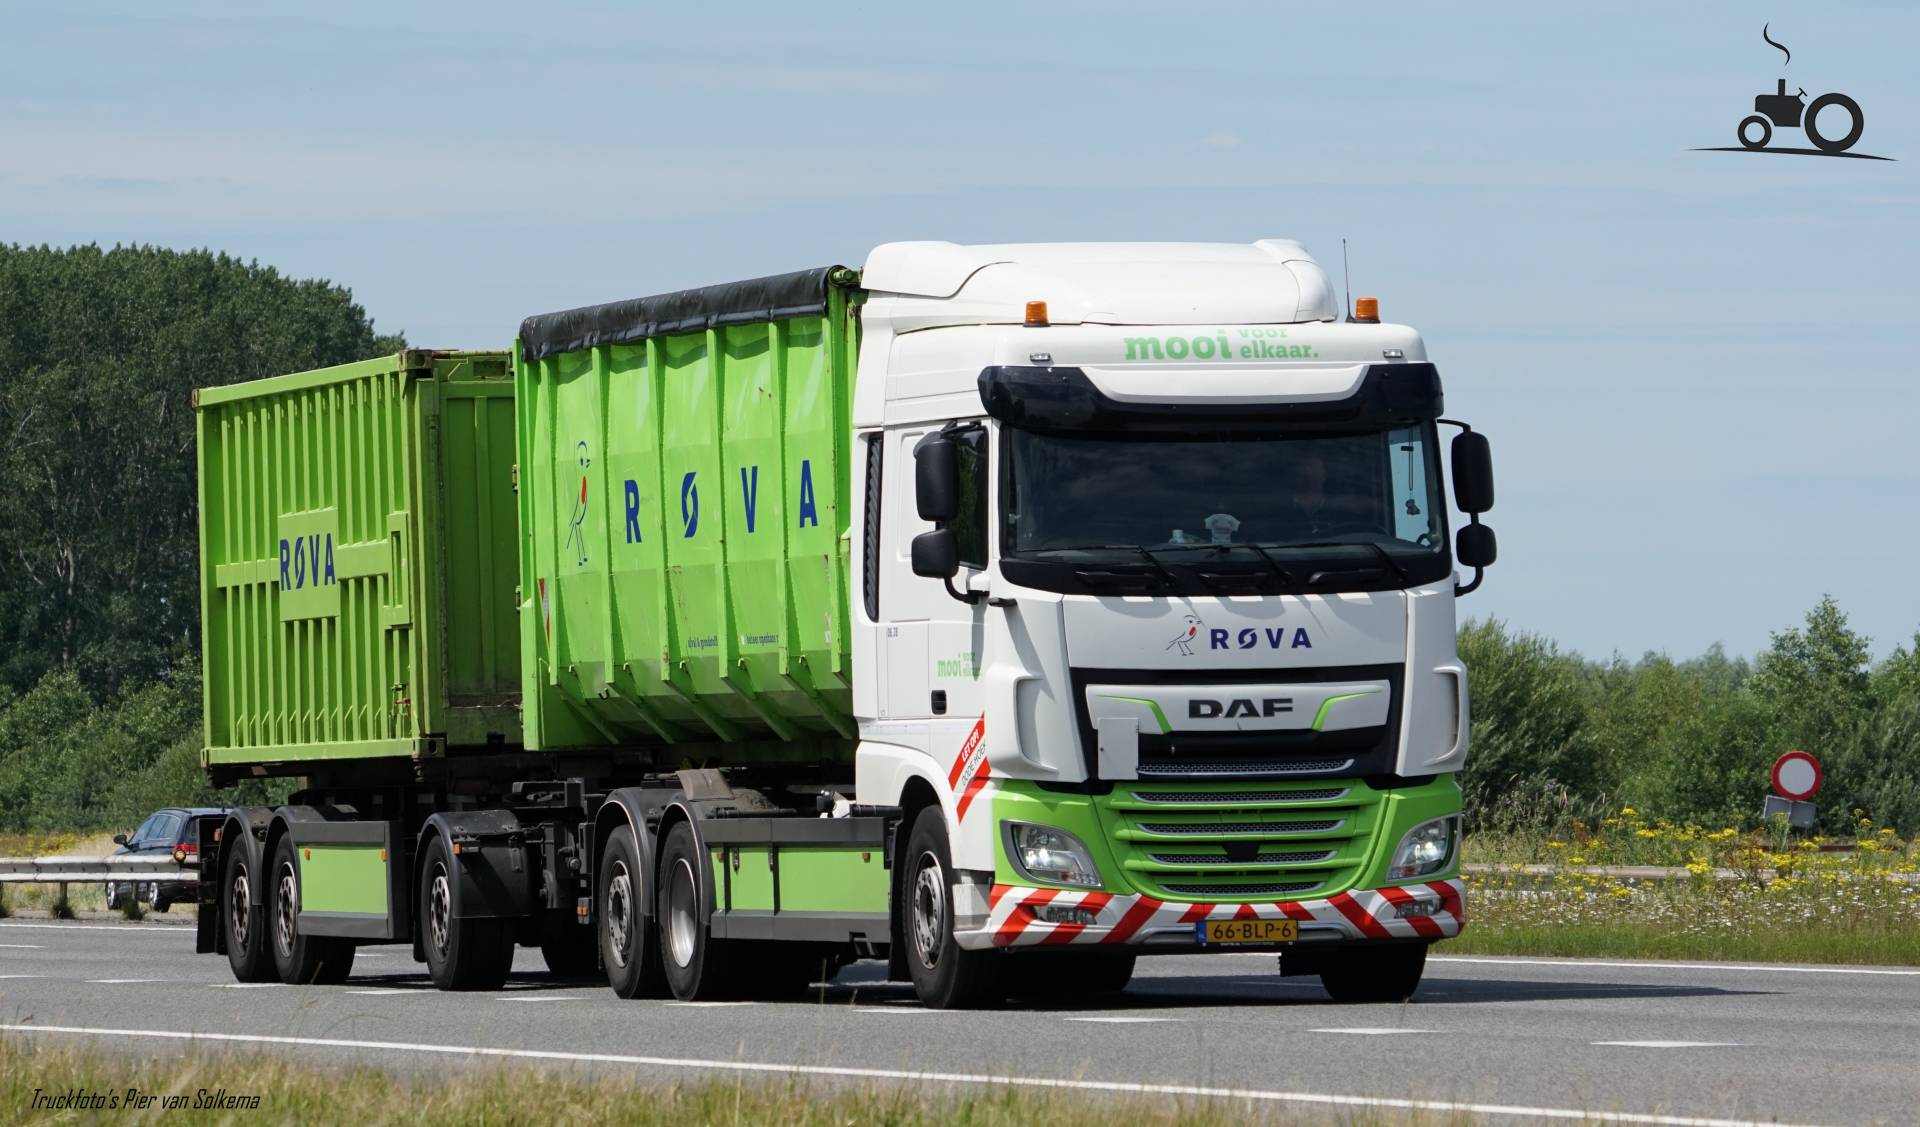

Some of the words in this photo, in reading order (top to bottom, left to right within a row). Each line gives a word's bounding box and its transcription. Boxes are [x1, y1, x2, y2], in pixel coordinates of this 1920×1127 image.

[1238, 329, 1288, 338] voor
[1123, 329, 1232, 360] mooi
[1239, 339, 1319, 359] elkaar.
[1188, 698, 1293, 718] DAF
[1213, 923, 1292, 939] 66-BLP-6
